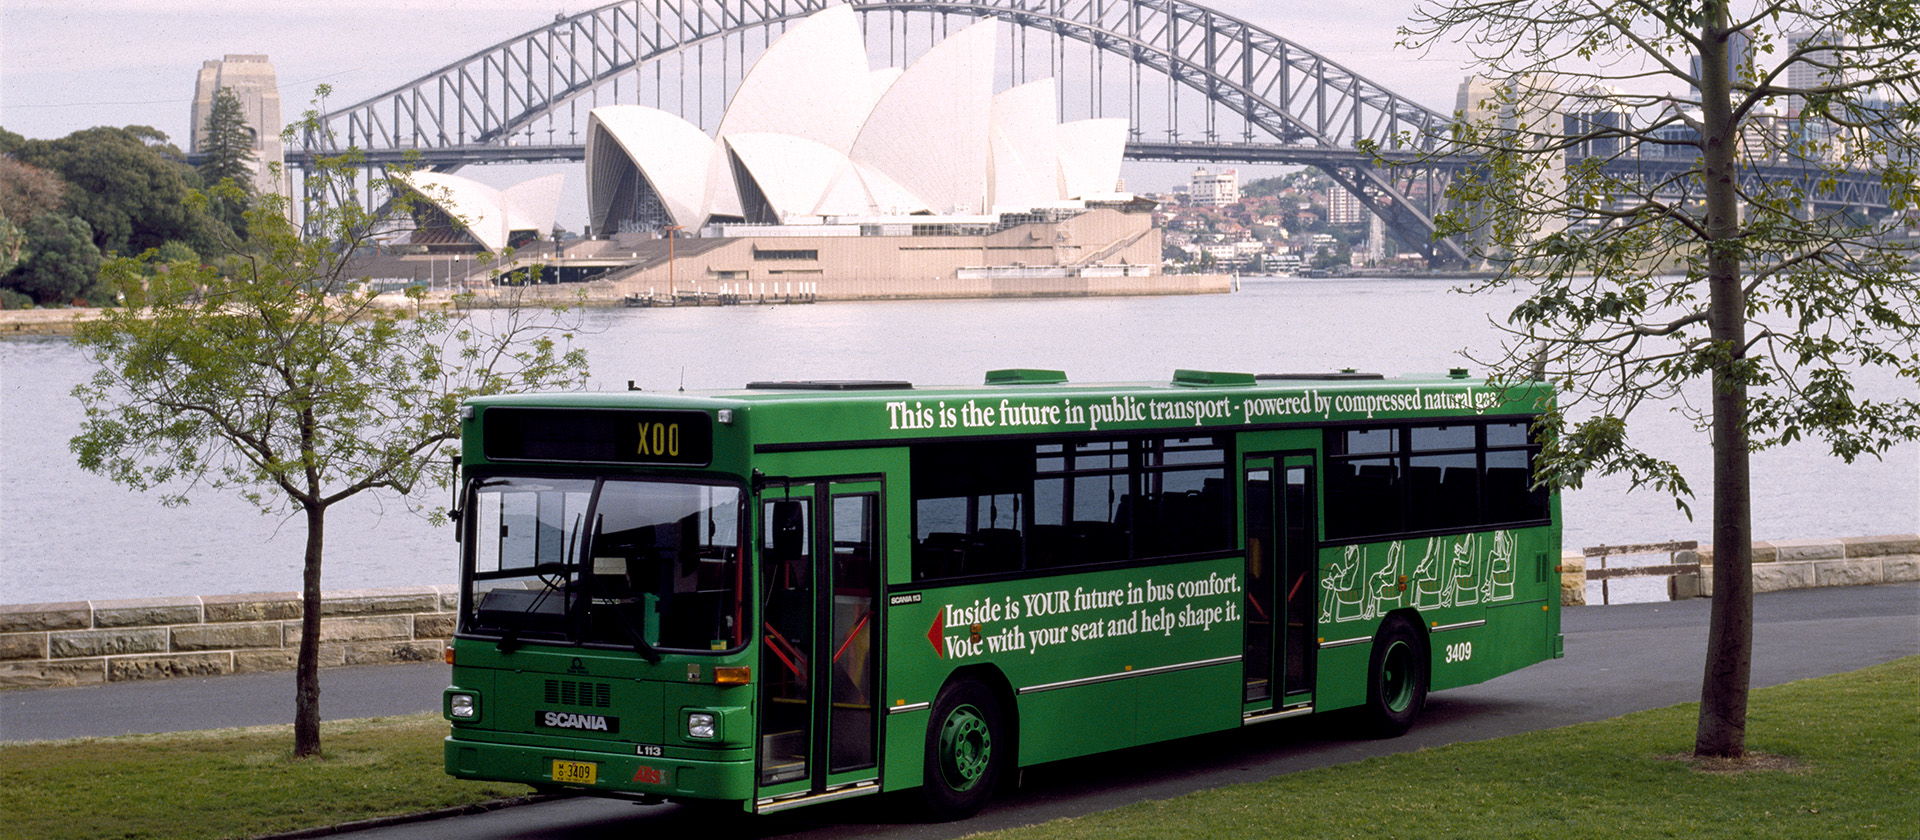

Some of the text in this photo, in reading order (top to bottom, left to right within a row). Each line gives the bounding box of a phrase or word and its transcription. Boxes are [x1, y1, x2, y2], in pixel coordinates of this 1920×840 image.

[886, 401, 934, 430] This
[939, 400, 957, 428] is
[961, 399, 995, 428] the
[999, 398, 1061, 427] future
[1065, 398, 1085, 425] in
[1089, 396, 1147, 431] public
[1149, 396, 1232, 426] transport
[1243, 389, 1312, 424] powered
[1314, 389, 1332, 419] by
[1335, 387, 1422, 419] compressed
[1424, 386, 1474, 411] natural
[891, 595, 912, 605] SCANIA
[945, 572, 1241, 629] Inside is YOUR future in bus comfort.
[945, 601, 1241, 660] Vote with your seat and help shape it.
[1445, 641, 1472, 664] 3409
[544, 711, 608, 731] SCANIA
[637, 745, 661, 756] L 113
[567, 764, 590, 779] 3409
